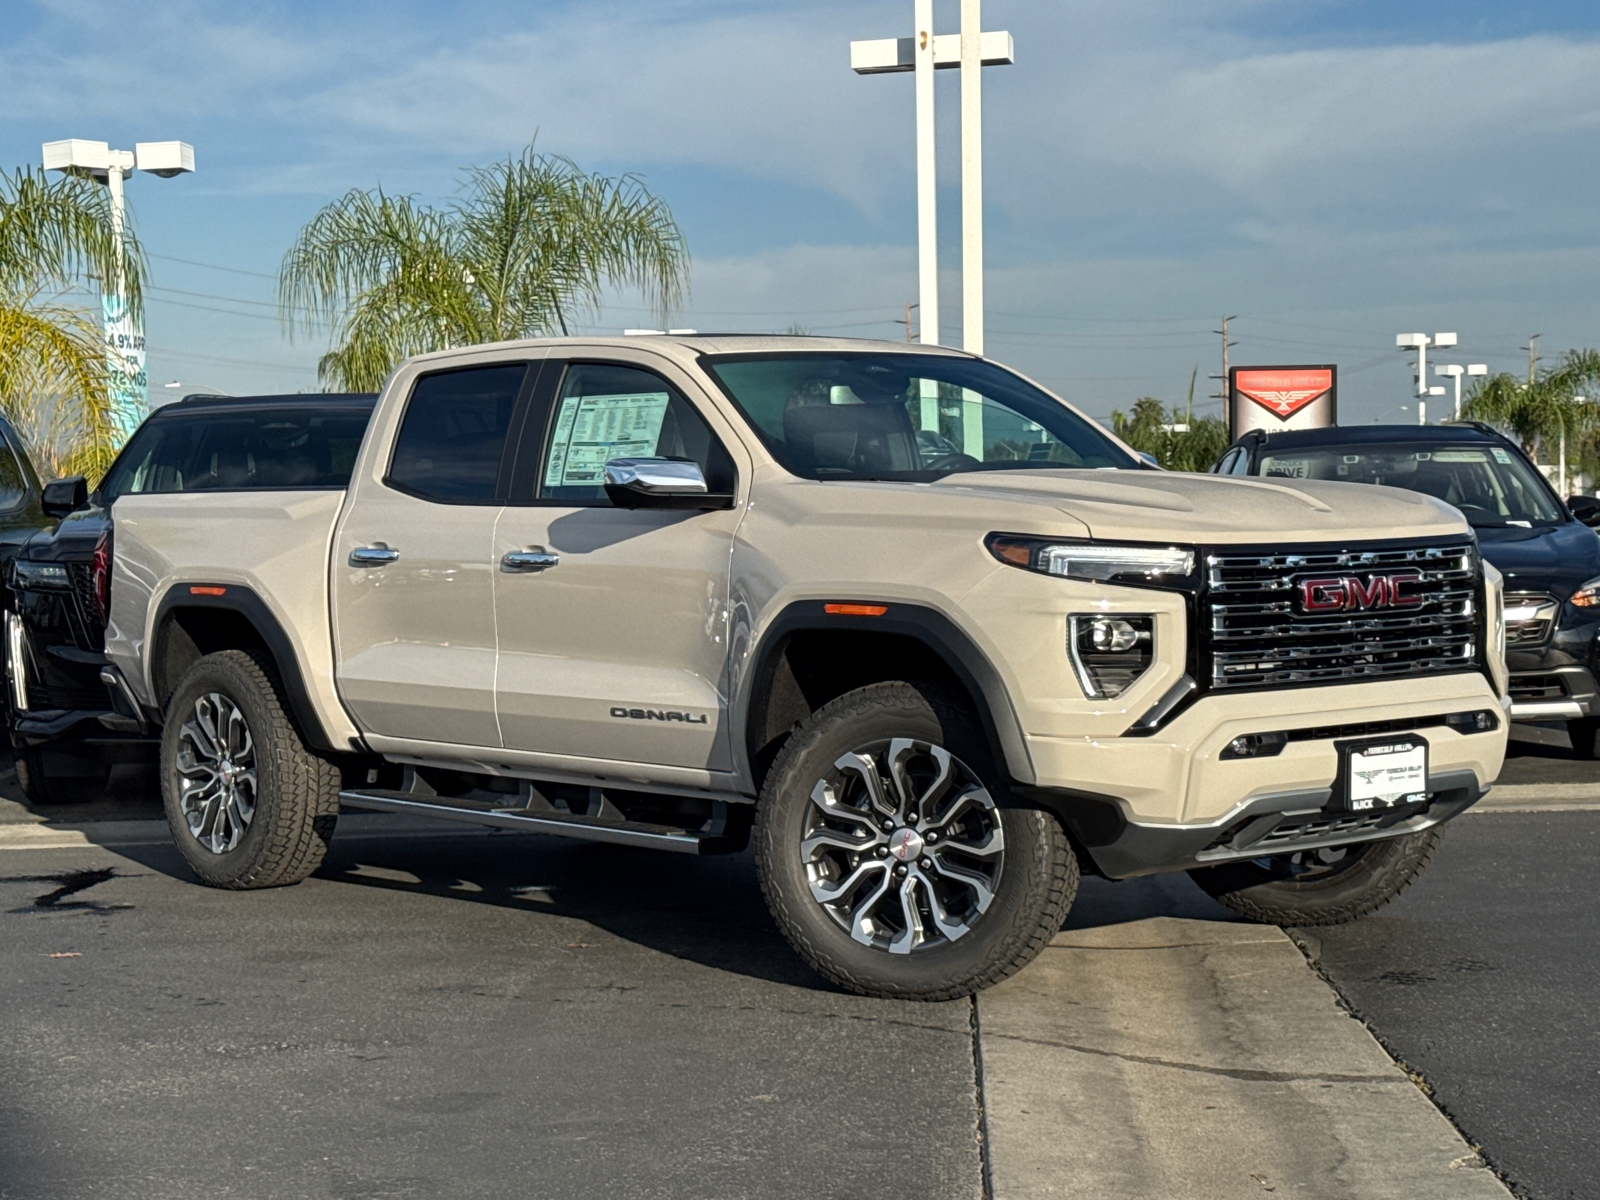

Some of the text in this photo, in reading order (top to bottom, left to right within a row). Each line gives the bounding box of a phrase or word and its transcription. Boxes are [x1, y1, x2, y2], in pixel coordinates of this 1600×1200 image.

[1302, 574, 1424, 611] GMC
[610, 706, 708, 724] DENALI
[1352, 793, 1426, 811] BUICK GMC
[900, 831, 911, 858] GMC
